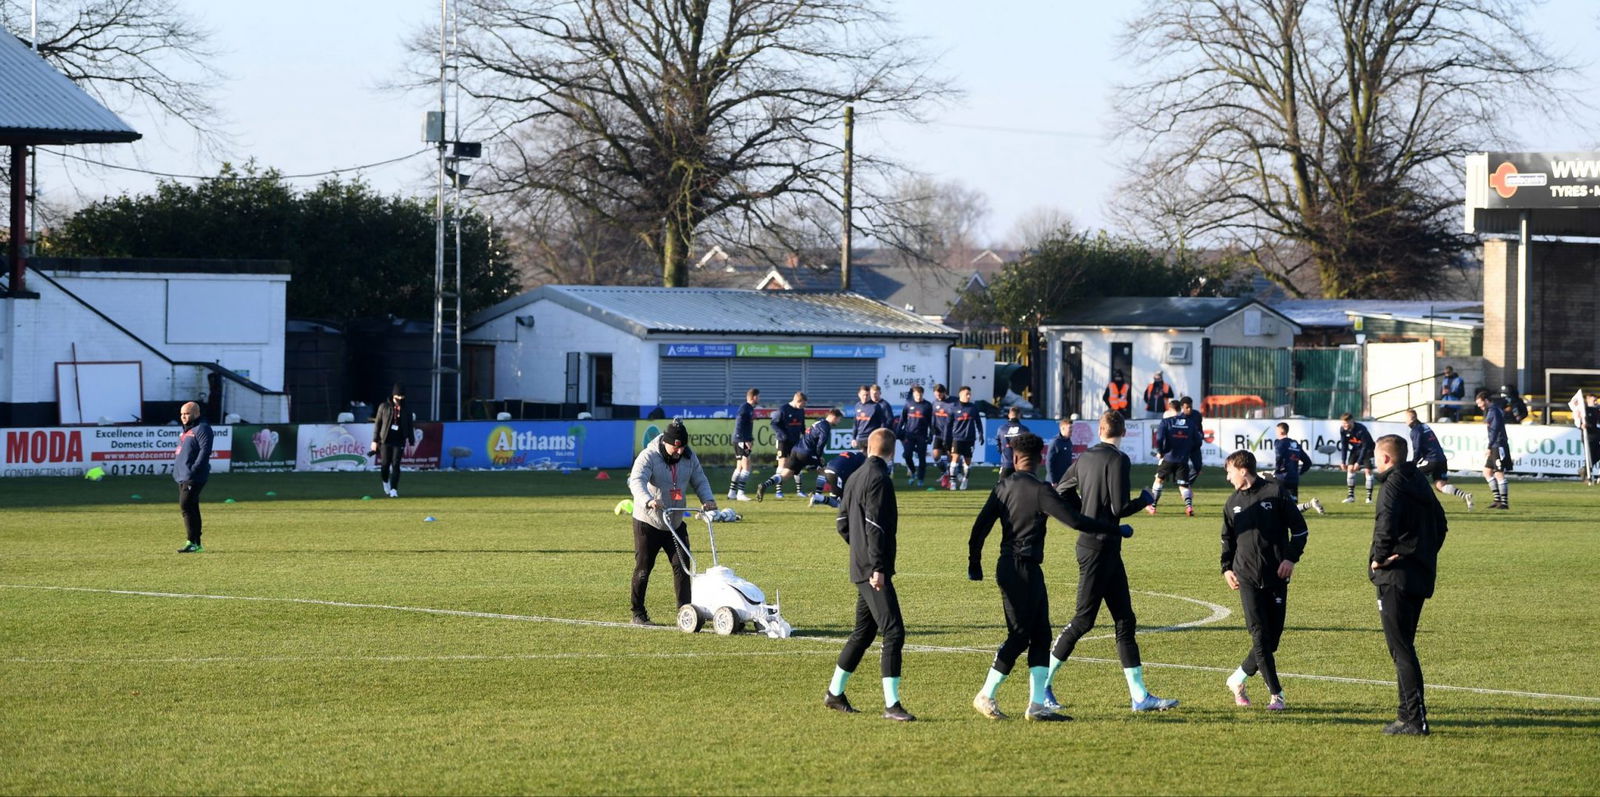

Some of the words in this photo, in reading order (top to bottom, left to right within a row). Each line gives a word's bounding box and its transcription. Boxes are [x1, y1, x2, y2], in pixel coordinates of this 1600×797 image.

[1550, 185, 1588, 197] TYRES
[96, 429, 143, 438] Excellence
[146, 429, 154, 437] in
[111, 440, 153, 449] Domestic
[495, 430, 576, 451] Althams
[830, 431, 853, 450] be
[6, 430, 84, 464] MODA
[309, 439, 365, 461] Fredericks
[1530, 458, 1561, 468] 01942
[4, 468, 65, 477] CONTRACTING
[111, 464, 154, 475] 01204
